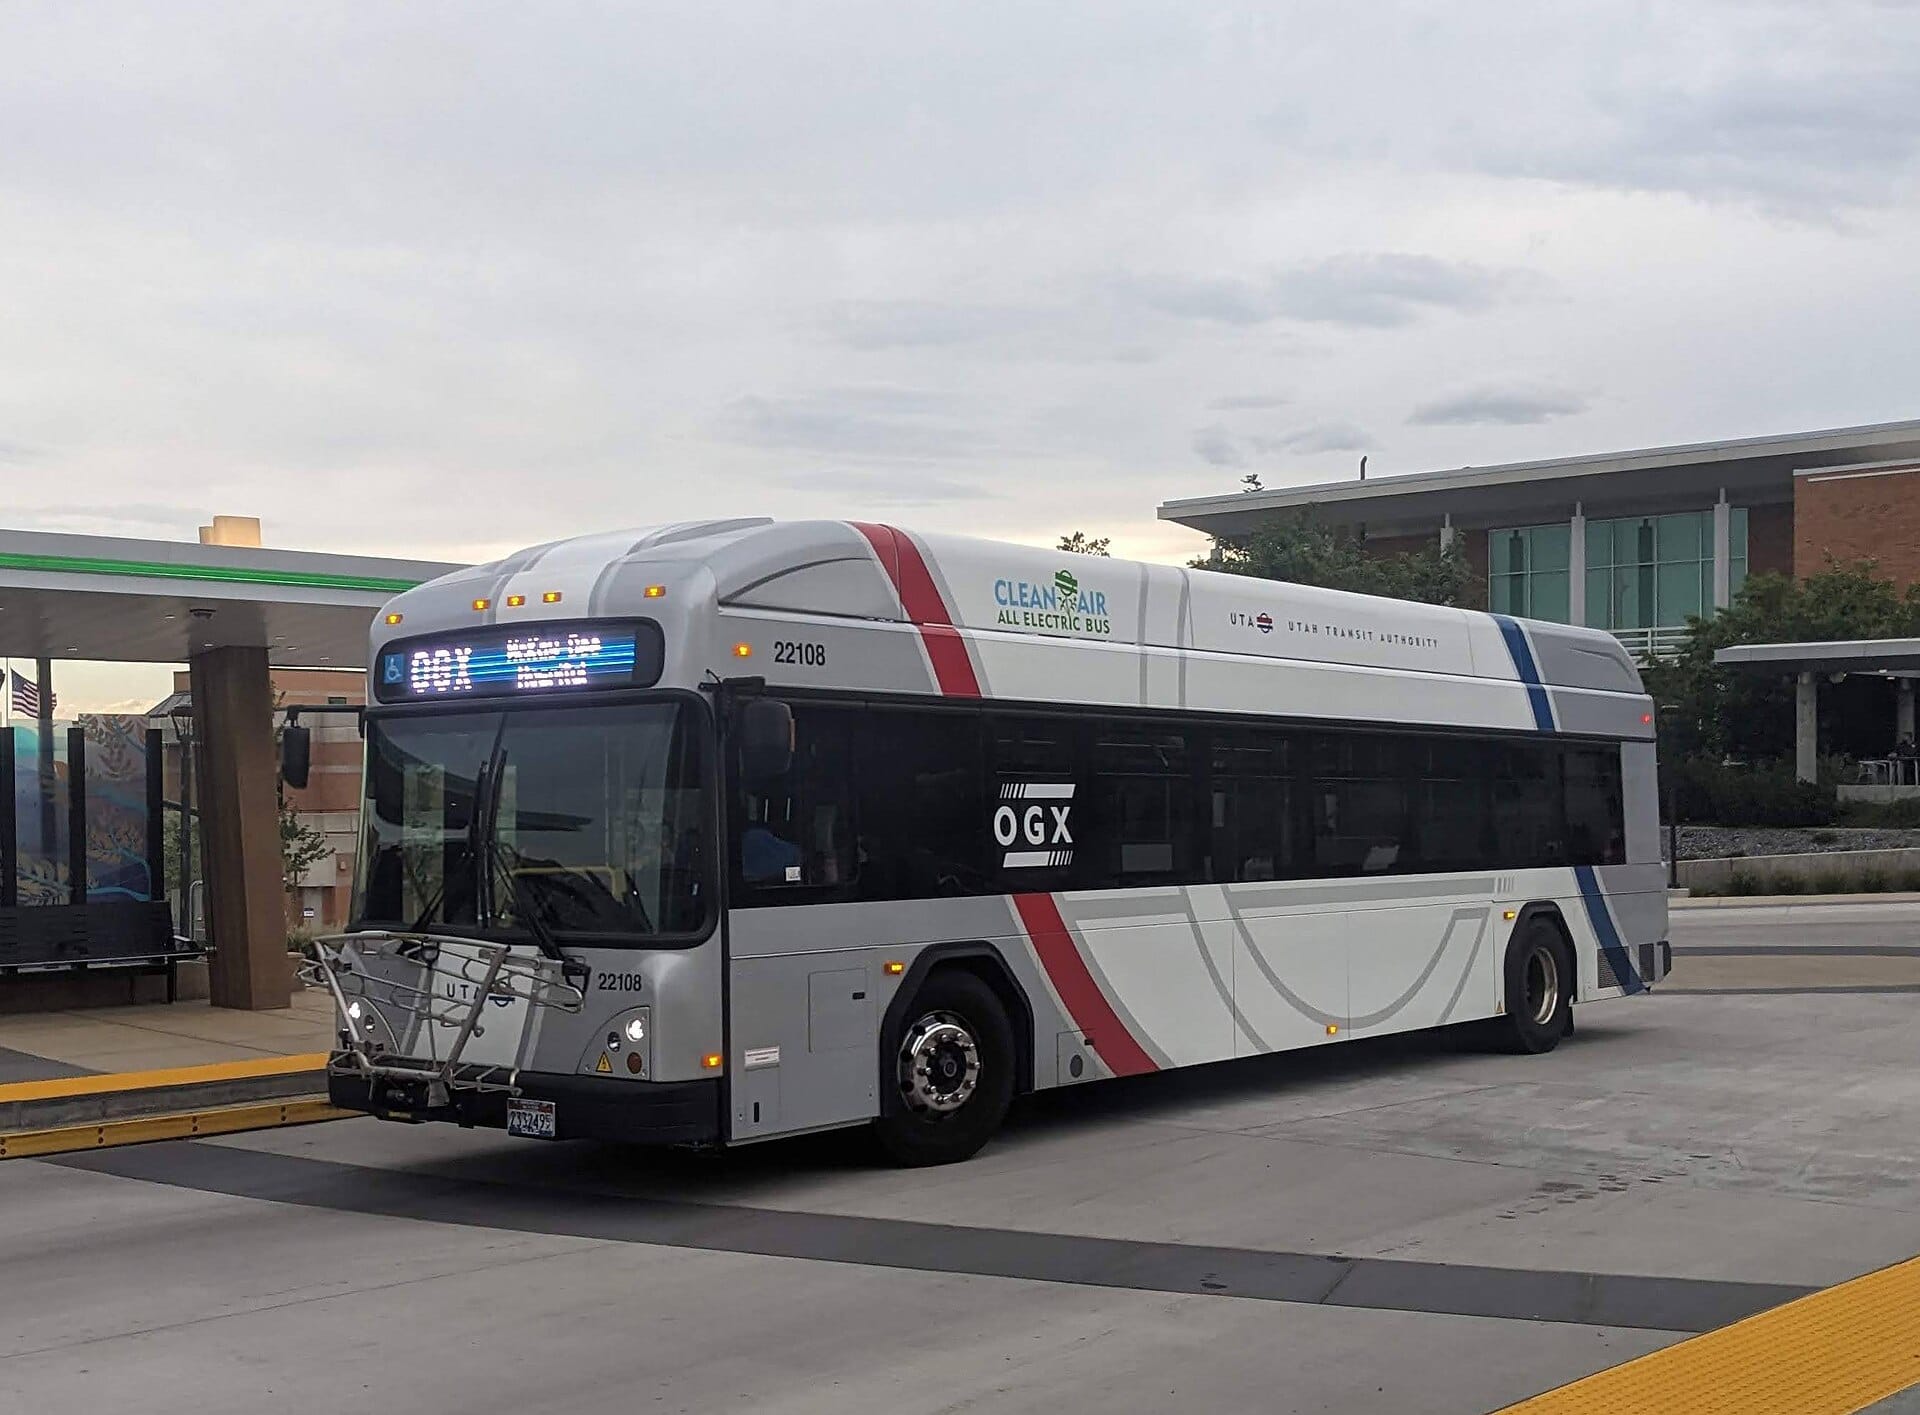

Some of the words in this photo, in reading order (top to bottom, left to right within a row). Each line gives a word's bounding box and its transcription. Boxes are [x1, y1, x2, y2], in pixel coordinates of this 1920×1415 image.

[994, 578, 1056, 610] CLEAN
[1076, 590, 1108, 616] AIR
[997, 609, 1020, 626] ALL
[1023, 611, 1081, 631] ELECTRIC
[1085, 618, 1111, 635] BUS
[1230, 612, 1255, 629] UTA
[1288, 620, 1319, 635] UTAH
[1325, 625, 1374, 642] TRANSIT
[1379, 633, 1440, 648] AUTHORITY
[774, 641, 826, 666] 22108
[994, 805, 1073, 846] OGX
[598, 973, 642, 992] 22108
